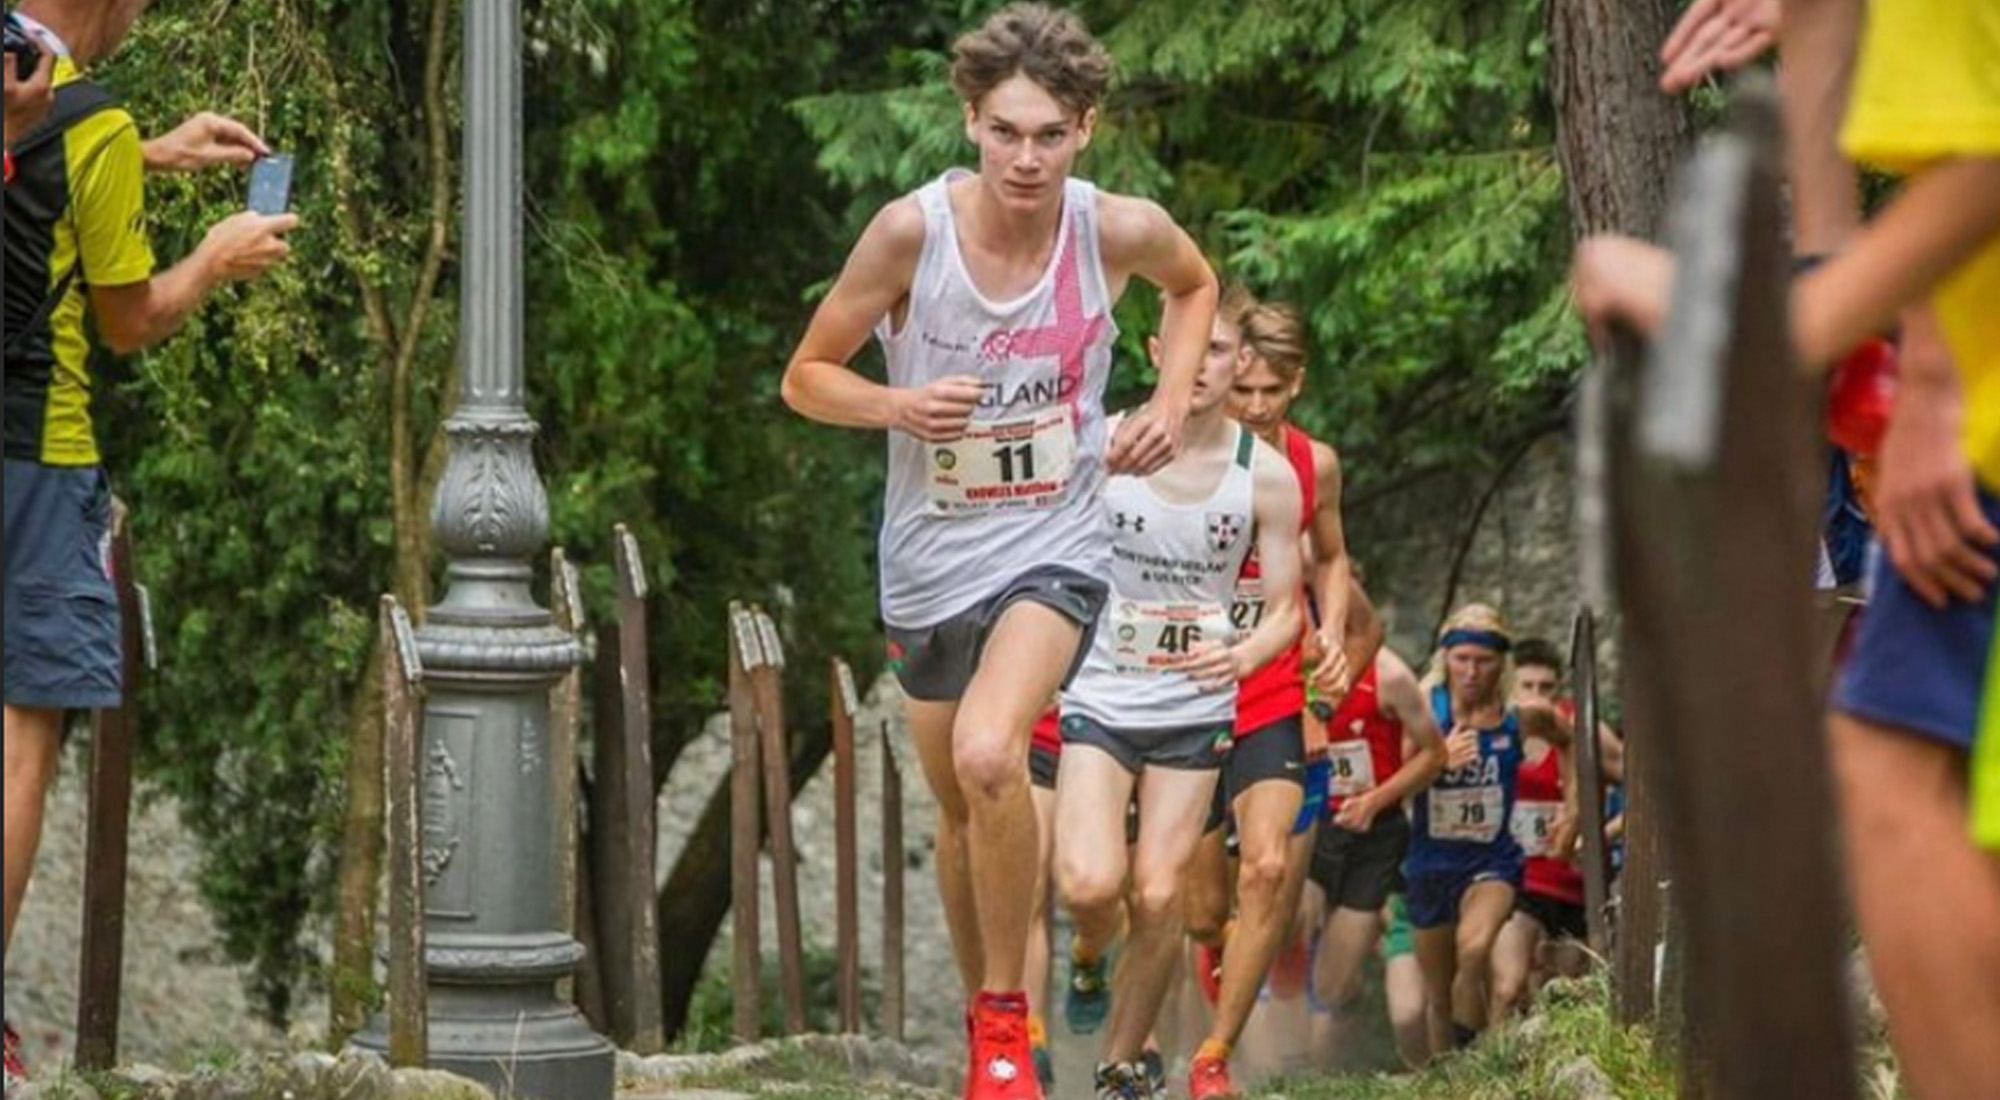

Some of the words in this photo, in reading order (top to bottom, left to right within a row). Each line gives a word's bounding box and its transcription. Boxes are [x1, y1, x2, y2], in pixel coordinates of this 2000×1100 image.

[976, 373, 1077, 408] GLAND
[992, 443, 1034, 482] 11
[1460, 803, 1485, 824] 79
